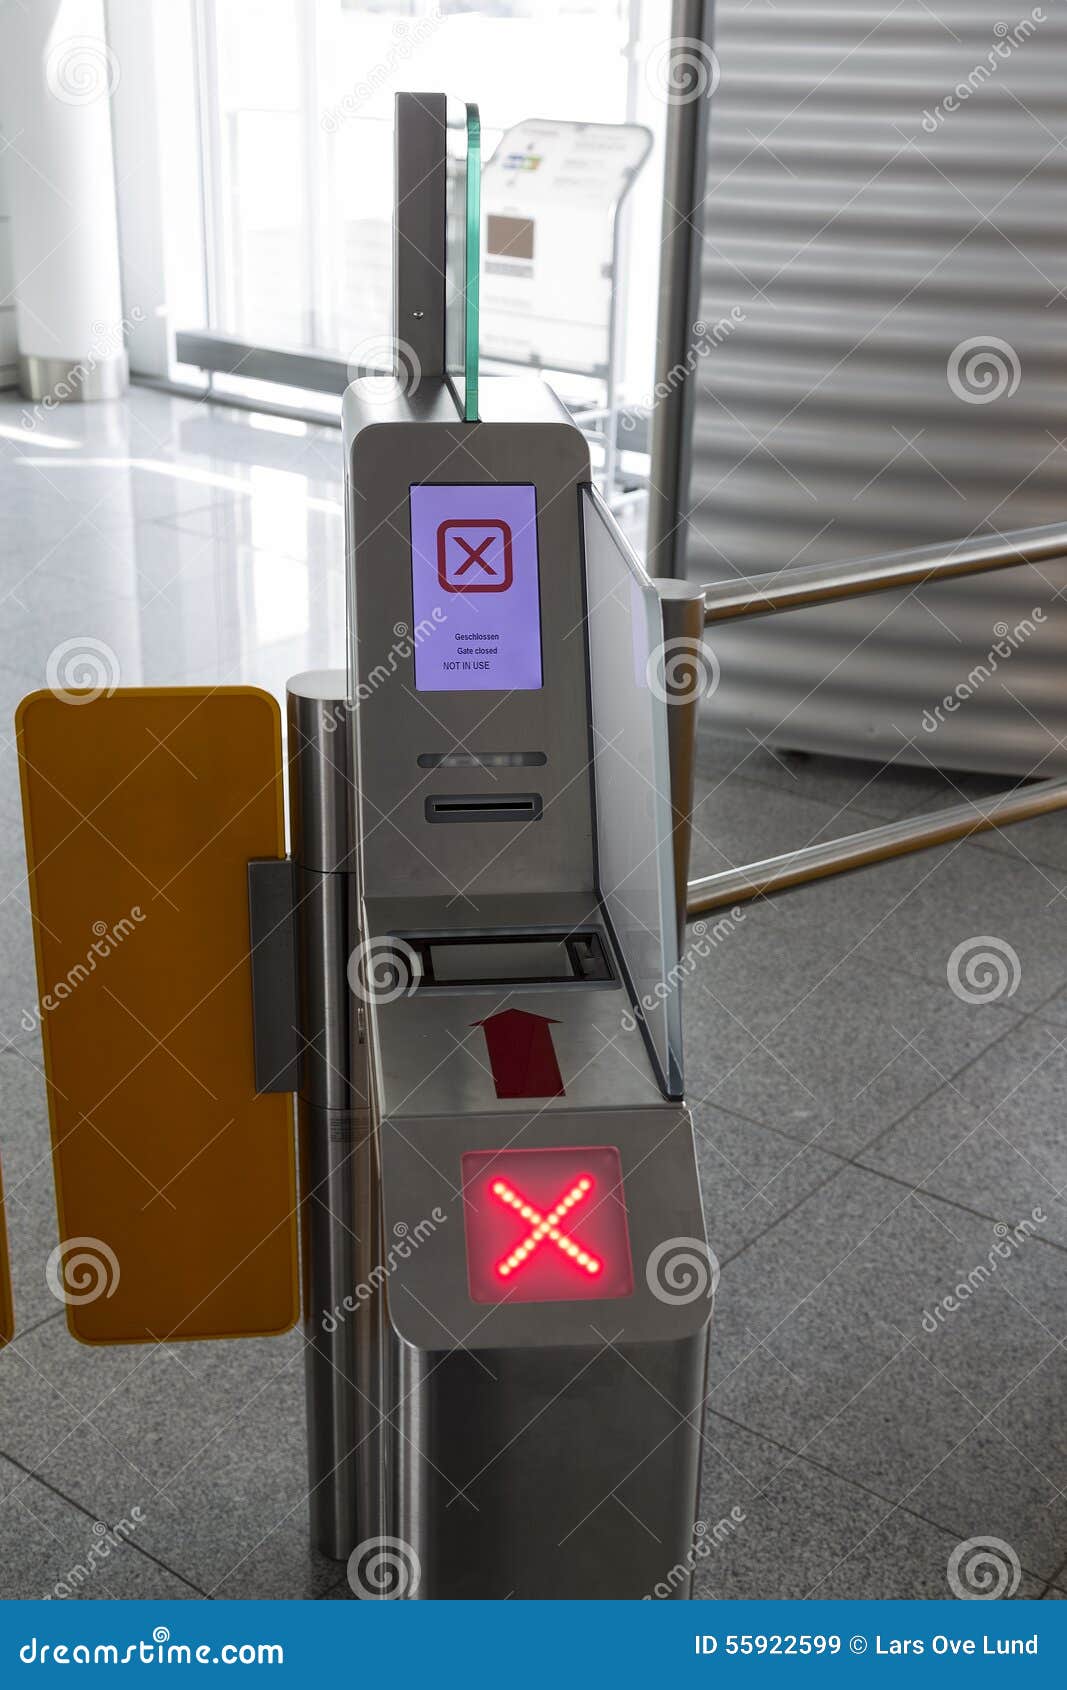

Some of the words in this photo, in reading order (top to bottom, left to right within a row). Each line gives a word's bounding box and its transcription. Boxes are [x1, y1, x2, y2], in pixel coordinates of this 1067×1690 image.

[455, 632, 499, 641] Geschlossen
[457, 647, 473, 655] Gate
[475, 646, 498, 655] closed
[443, 661, 460, 670] NOT
[462, 661, 471, 670] IN
[473, 661, 490, 670] USE
